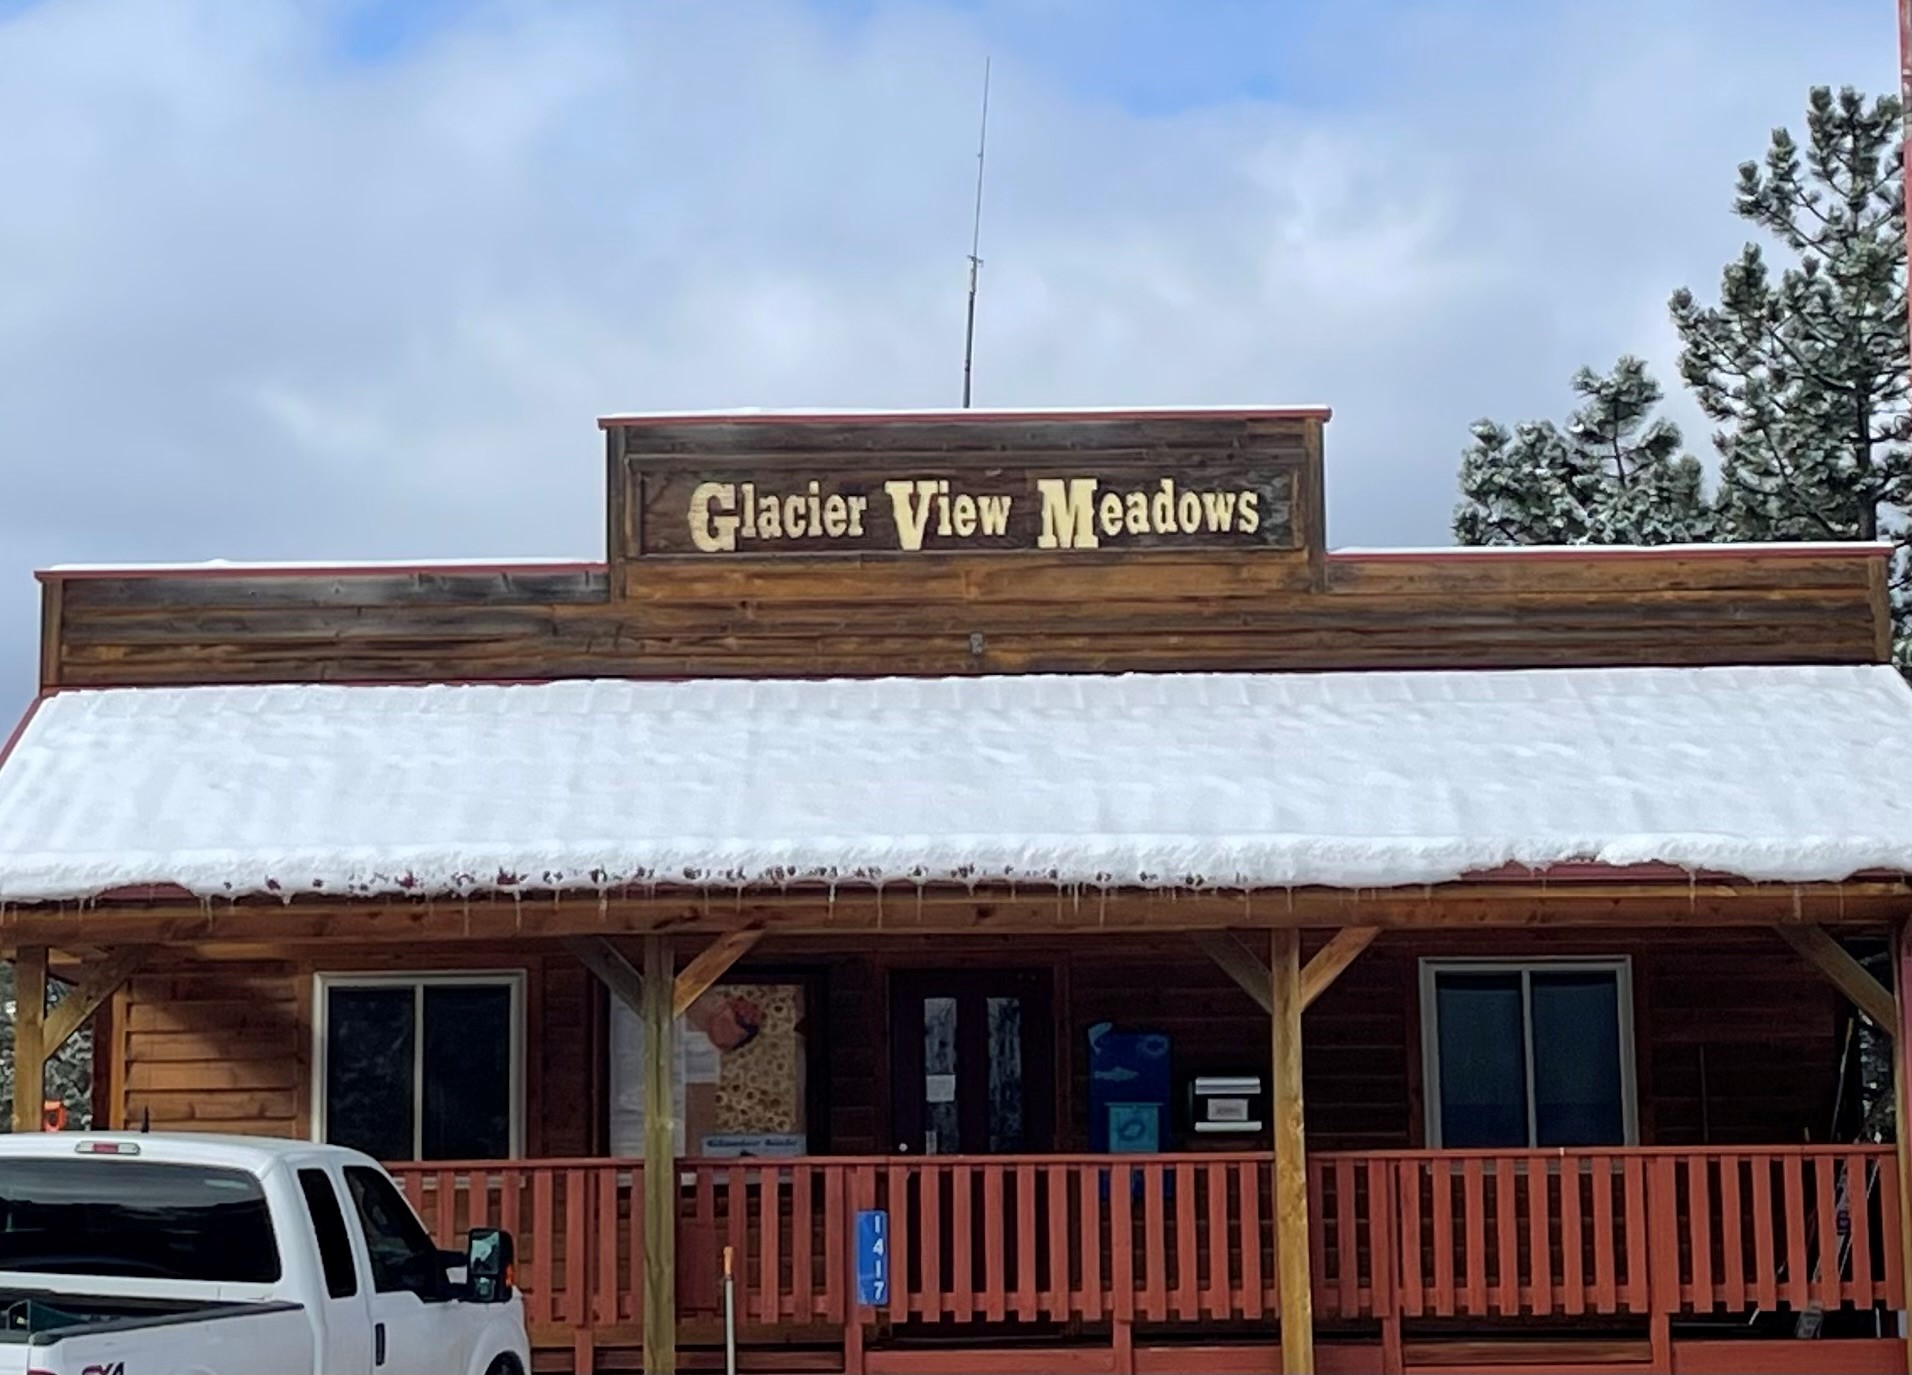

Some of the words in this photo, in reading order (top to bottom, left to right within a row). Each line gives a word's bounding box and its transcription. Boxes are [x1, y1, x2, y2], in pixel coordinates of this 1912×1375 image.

[687, 481, 867, 552] Glacier
[884, 479, 1012, 551] View
[1036, 477, 1260, 550] Meadows
[872, 1215, 884, 1300] 1417
